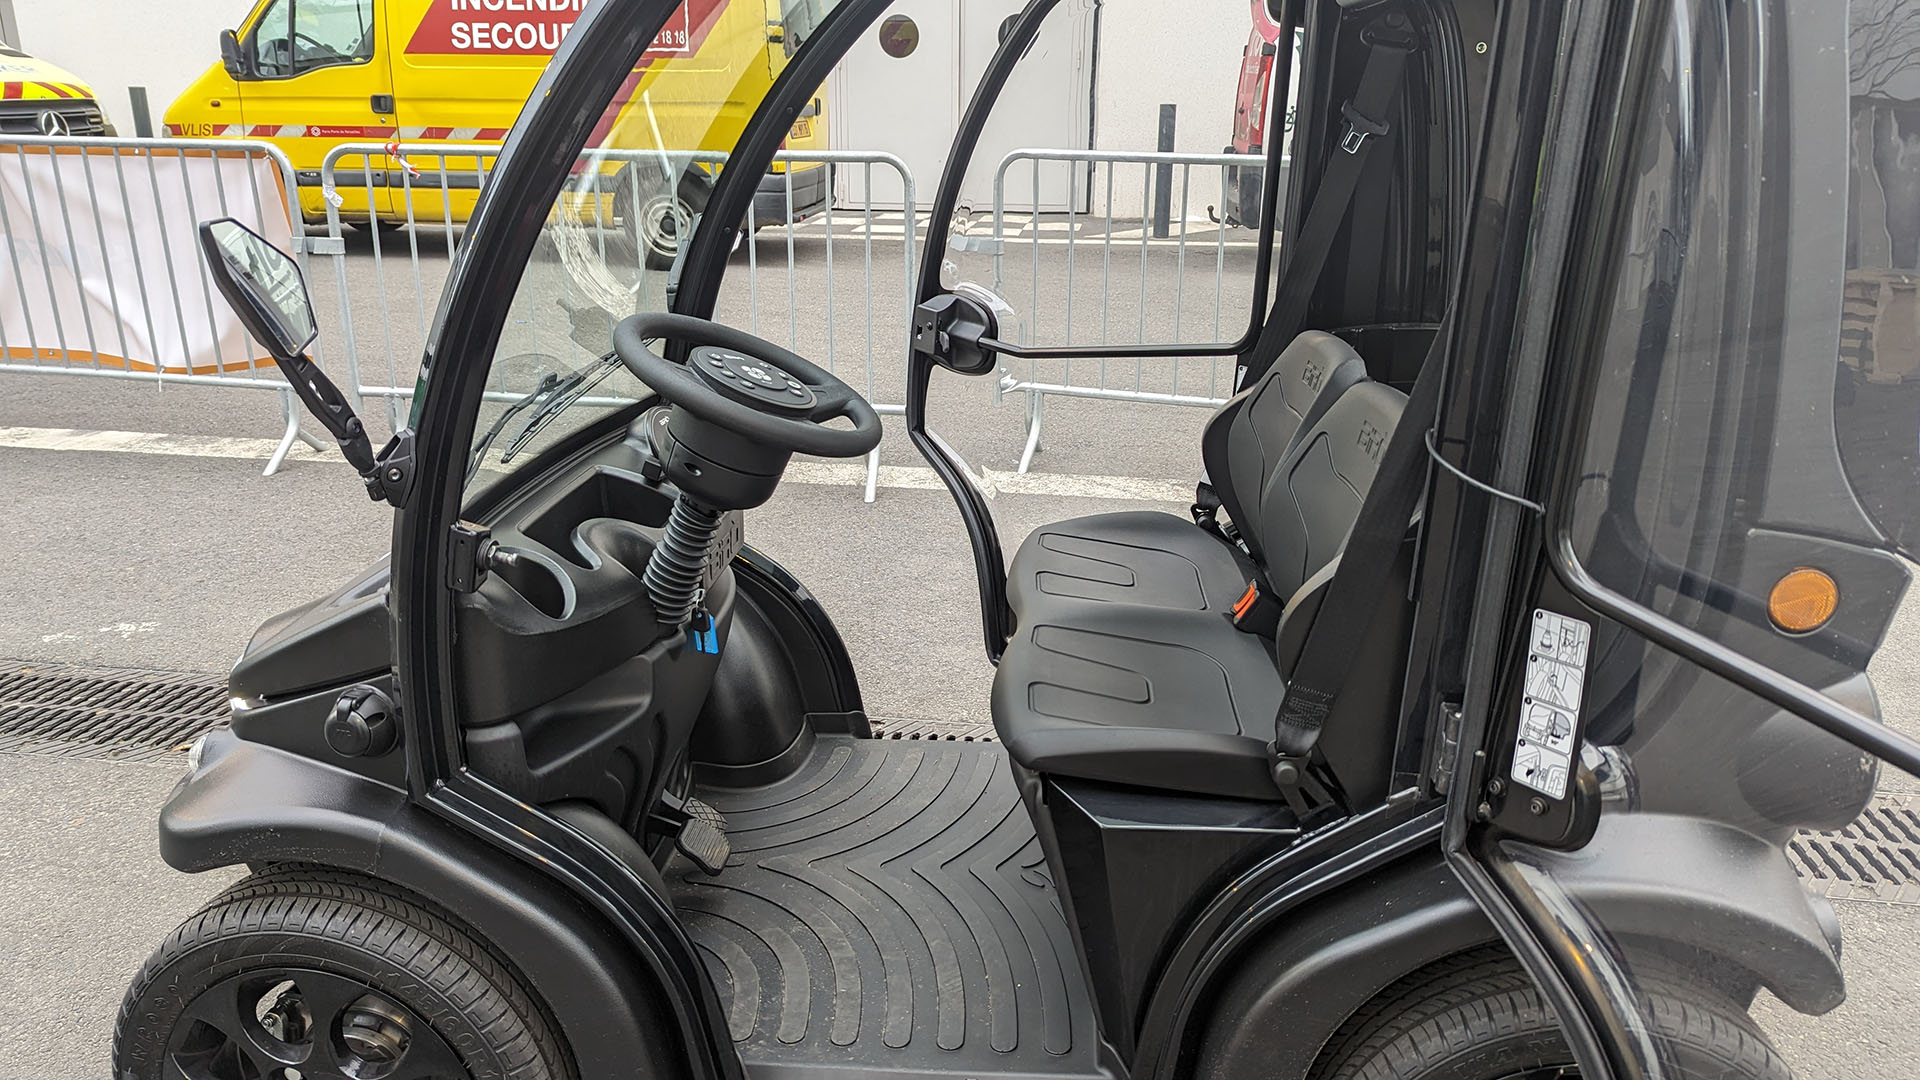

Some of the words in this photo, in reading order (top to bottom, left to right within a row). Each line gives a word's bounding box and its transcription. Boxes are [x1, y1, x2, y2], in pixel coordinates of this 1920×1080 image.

[661, 30, 672, 44] 18
[674, 30, 685, 44] 18
[182, 123, 212, 137] VLIS
